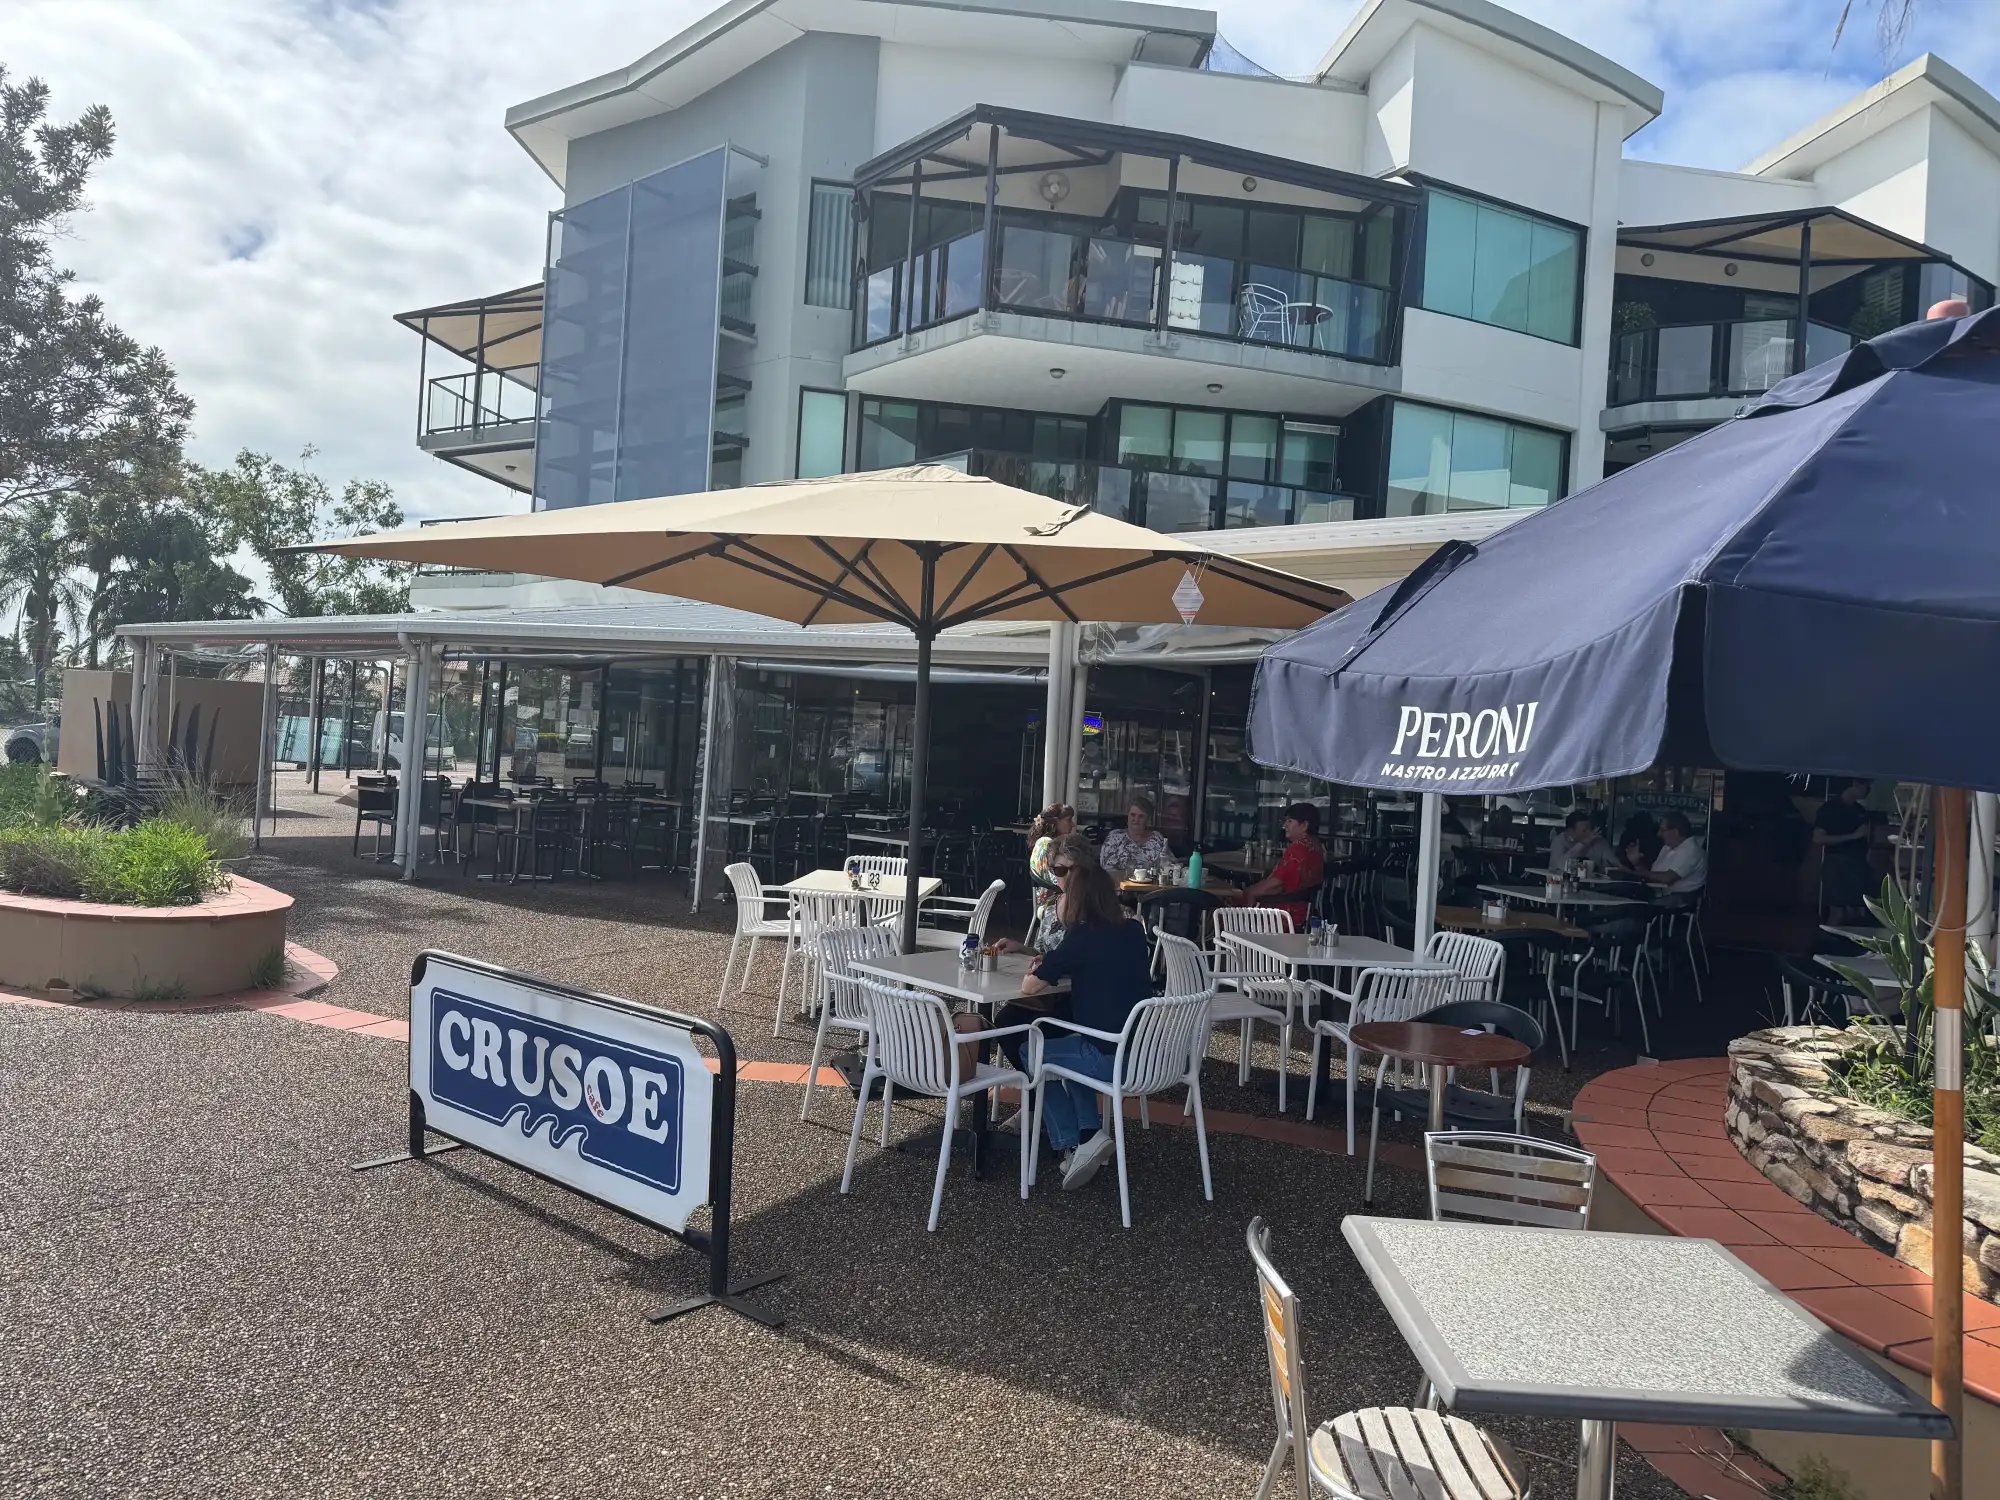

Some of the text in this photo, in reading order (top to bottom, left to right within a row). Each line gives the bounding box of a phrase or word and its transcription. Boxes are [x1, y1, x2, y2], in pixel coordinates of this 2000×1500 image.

[1391, 701, 1539, 758] PERONI
[1380, 762, 1447, 780] NASTRO
[869, 872, 880, 885] 23
[439, 1010, 669, 1145] CRUSOE
[587, 1084, 604, 1118] cafe
